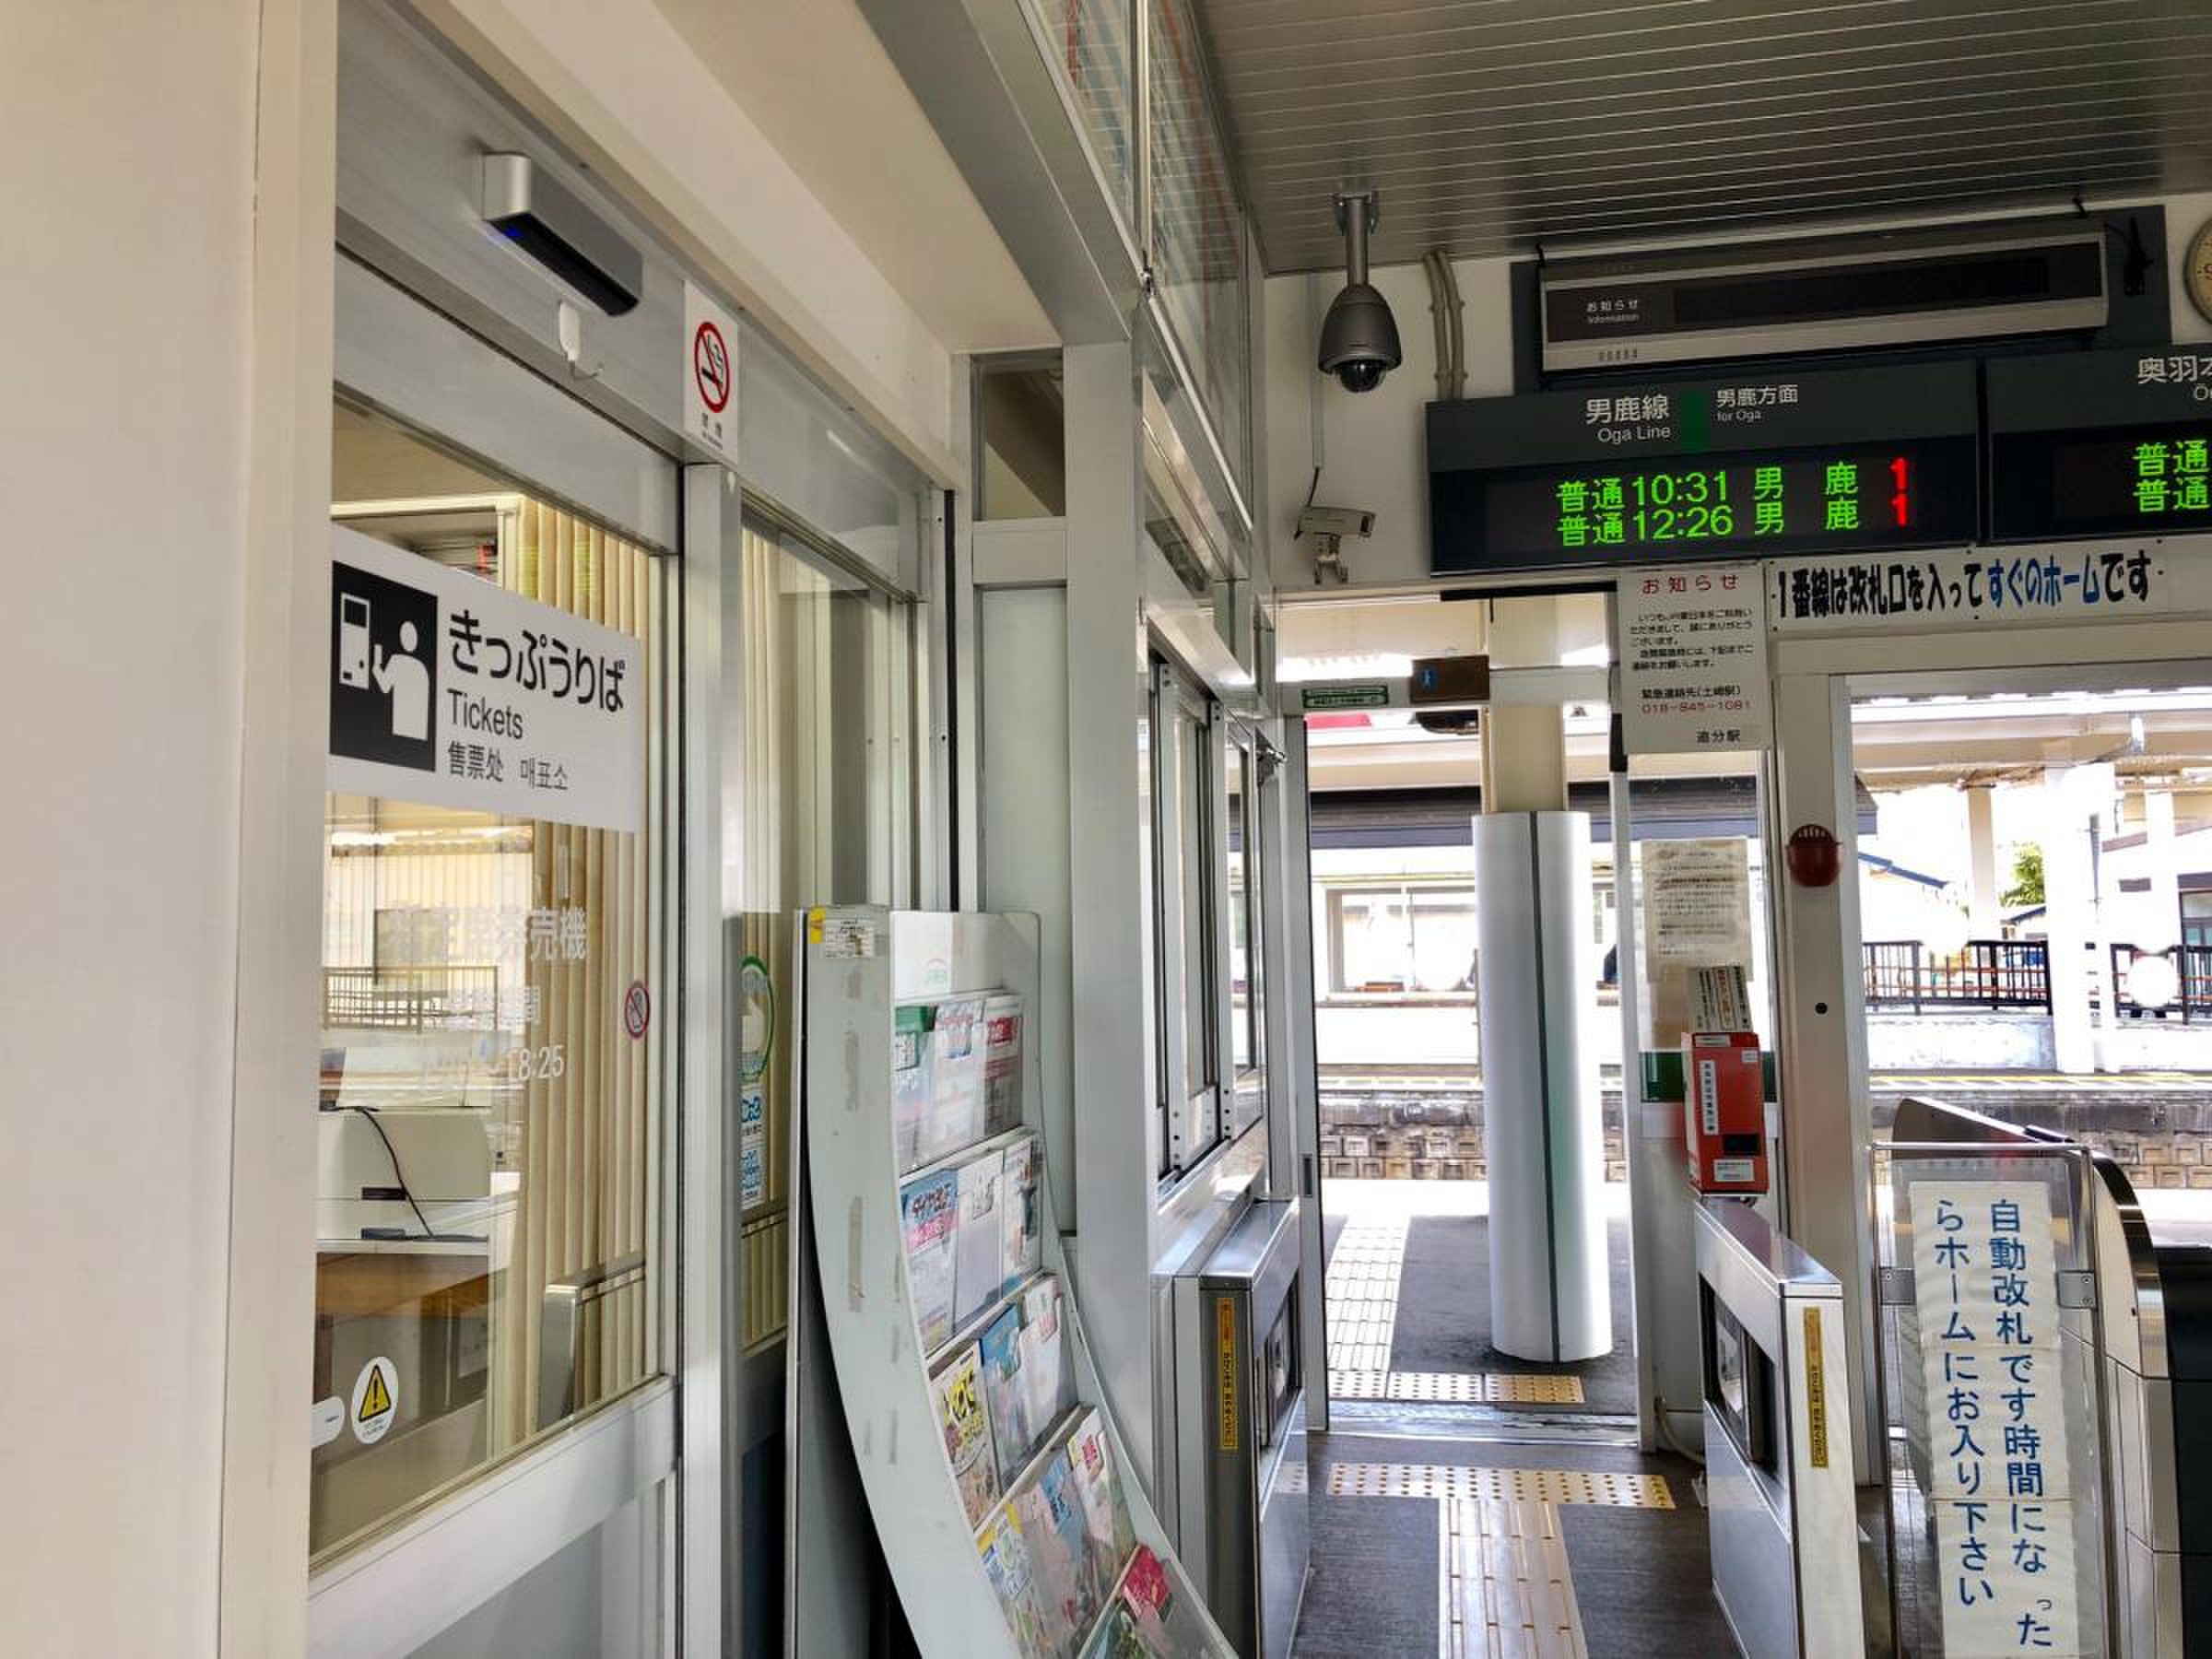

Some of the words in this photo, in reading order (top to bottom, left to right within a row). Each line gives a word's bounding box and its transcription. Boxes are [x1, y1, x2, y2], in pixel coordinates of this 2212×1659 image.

[1586, 300, 1639, 313] お知らせ
[1586, 394, 1670, 425] 男鹿線
[1716, 383, 1798, 409] 男鹿方面
[1717, 411, 1733, 422] for
[1735, 409, 1761, 423] Oga
[1597, 428, 1631, 444] Oga
[1637, 426, 1671, 441] Line
[2133, 439, 2210, 477] 普通
[1557, 477, 1625, 513] 普通
[1632, 471, 1728, 507] 10:31
[1891, 458, 1907, 491] 1
[2133, 475, 2210, 512] 普通
[1557, 512, 1625, 547] 普通
[1634, 505, 1734, 541] 12:26
[1891, 493, 1908, 526] 1
[1641, 574, 1739, 594] お知らせ
[449, 608, 626, 713] きっぷうりば
[447, 688, 524, 739] Tickets
[520, 757, 569, 791] 매표소
[1936, 1199, 1994, 1606] らホームにお入り下さい
[1988, 1198, 2053, 1648] 自動改札です時間になった
